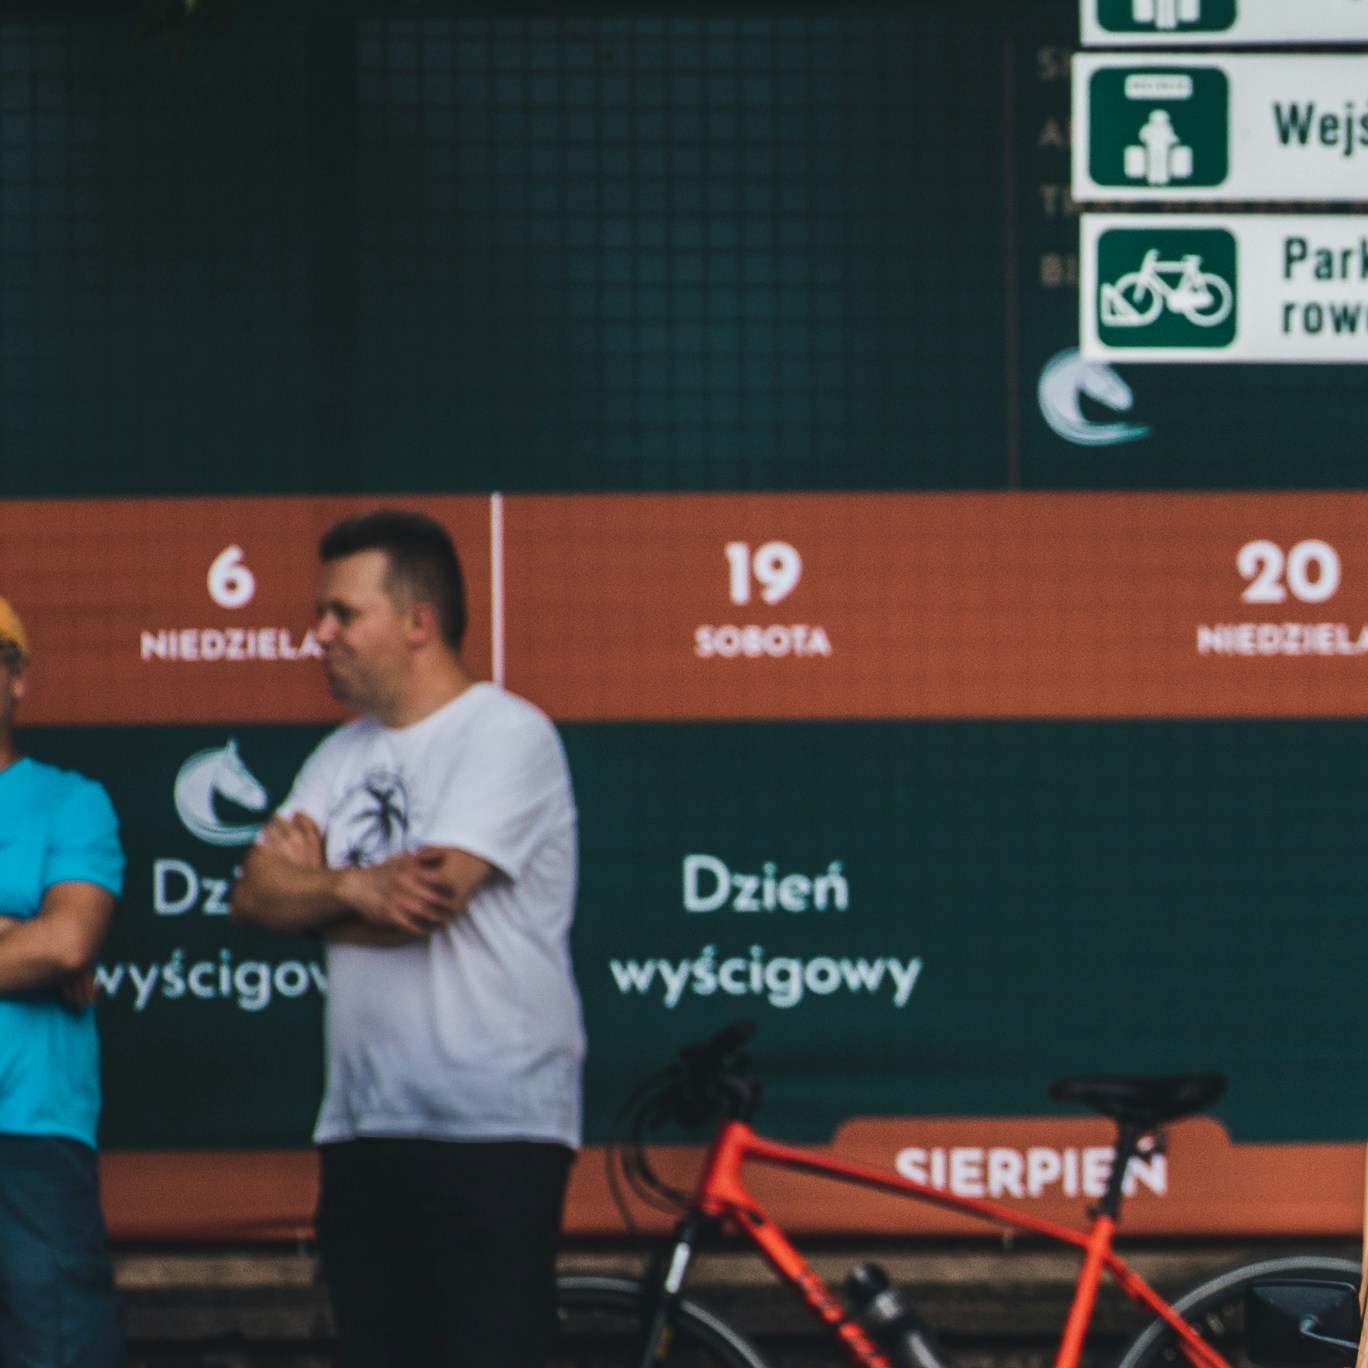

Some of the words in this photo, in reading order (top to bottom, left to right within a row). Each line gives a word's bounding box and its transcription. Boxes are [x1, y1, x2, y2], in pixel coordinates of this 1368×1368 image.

[207, 545, 255, 610] 6
[724, 540, 803, 606] 19
[1235, 538, 1342, 605] 20
[140, 628, 318, 662] NIEDZIELA
[694, 623, 833, 659] SOBOTA
[682, 850, 849, 913] Dzień
[609, 944, 922, 1009] wyścigowy
